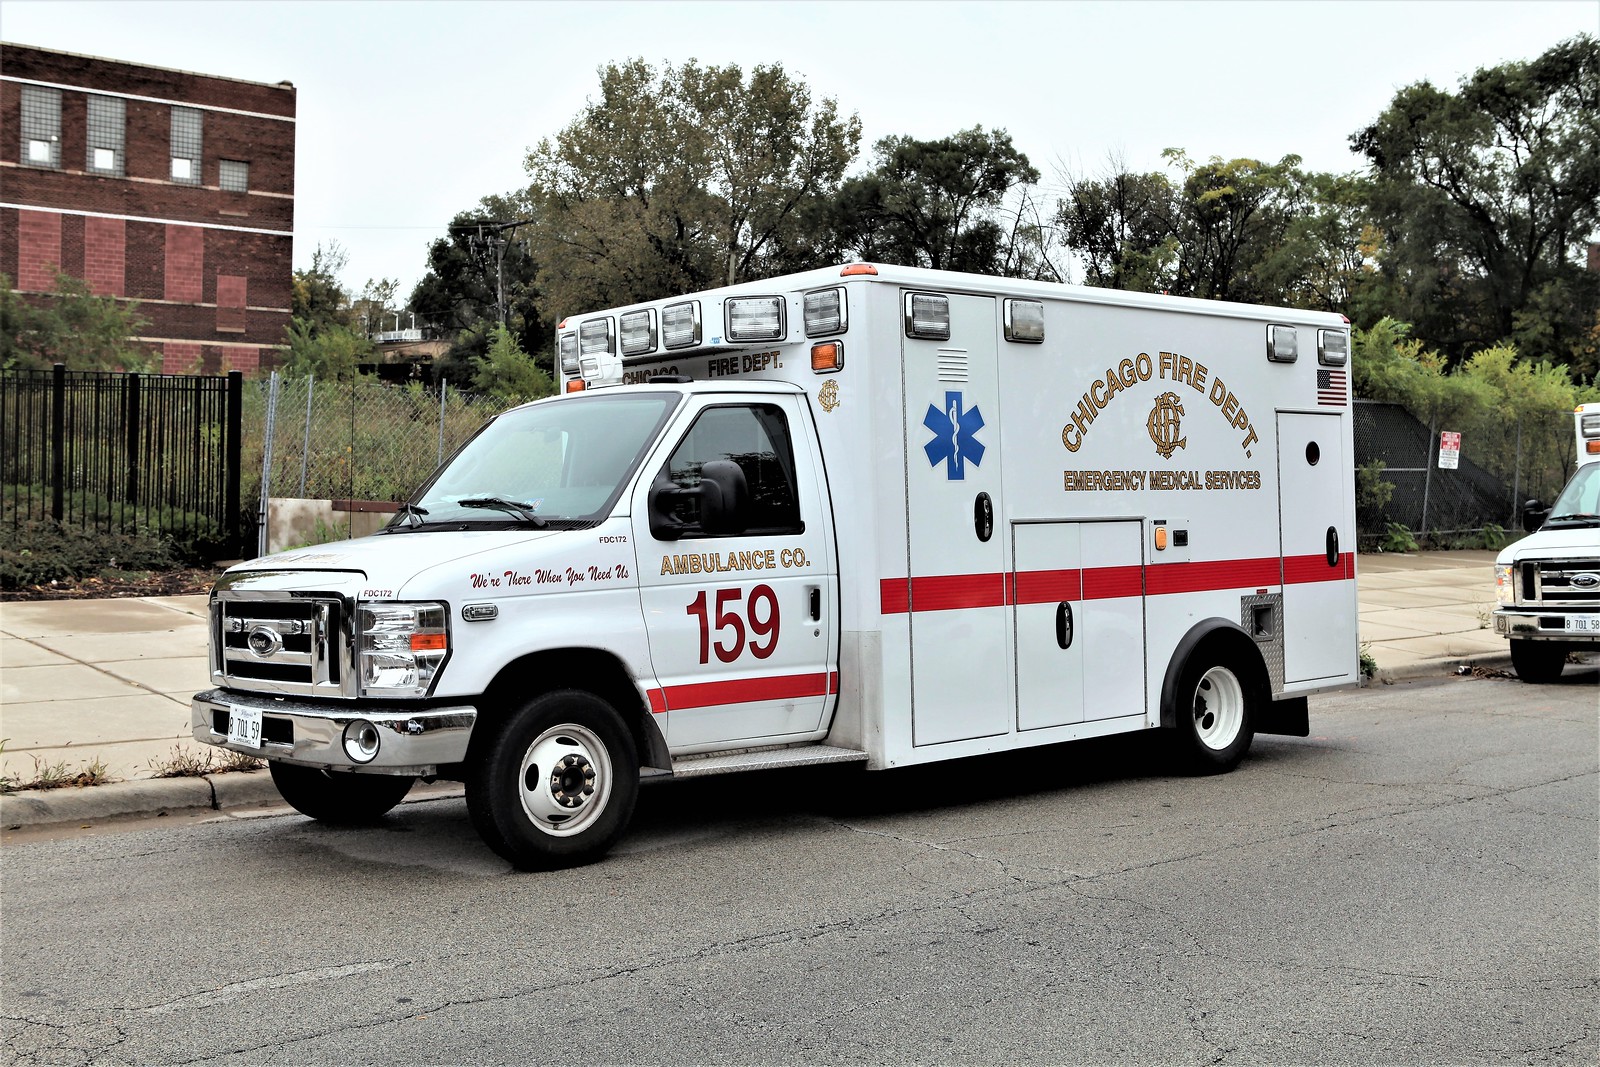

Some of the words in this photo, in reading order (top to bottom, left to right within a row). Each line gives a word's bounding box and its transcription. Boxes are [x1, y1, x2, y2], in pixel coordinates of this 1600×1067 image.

[708, 358, 739, 377] FIRE
[743, 351, 783, 373] DEPT.
[1061, 352, 1152, 453] CHICAGO
[1159, 351, 1208, 394] FIRE
[1209, 377, 1259, 459] DEPT.
[1064, 471, 1146, 491] EMERGENCY
[1150, 471, 1203, 491] MEDICAL
[1205, 470, 1261, 490] SERVICES
[599, 536, 627, 544] FDC172
[661, 550, 776, 575] AMBULANCE
[780, 548, 811, 568] CO.
[470, 572, 501, 588] We're
[504, 570, 531, 586] There
[535, 569, 562, 584] When
[565, 566, 585, 586] You
[588, 565, 612, 581] Need
[615, 564, 629, 579] Us
[686, 584, 780, 664] 159
[1566, 619, 1571, 629] 8
[1574, 619, 1587, 630] 701
[1591, 619, 1600, 630] 58
[252, 637, 266, 648] Ford
[237, 718, 248, 738] 701
[252, 720, 260, 740] 59
